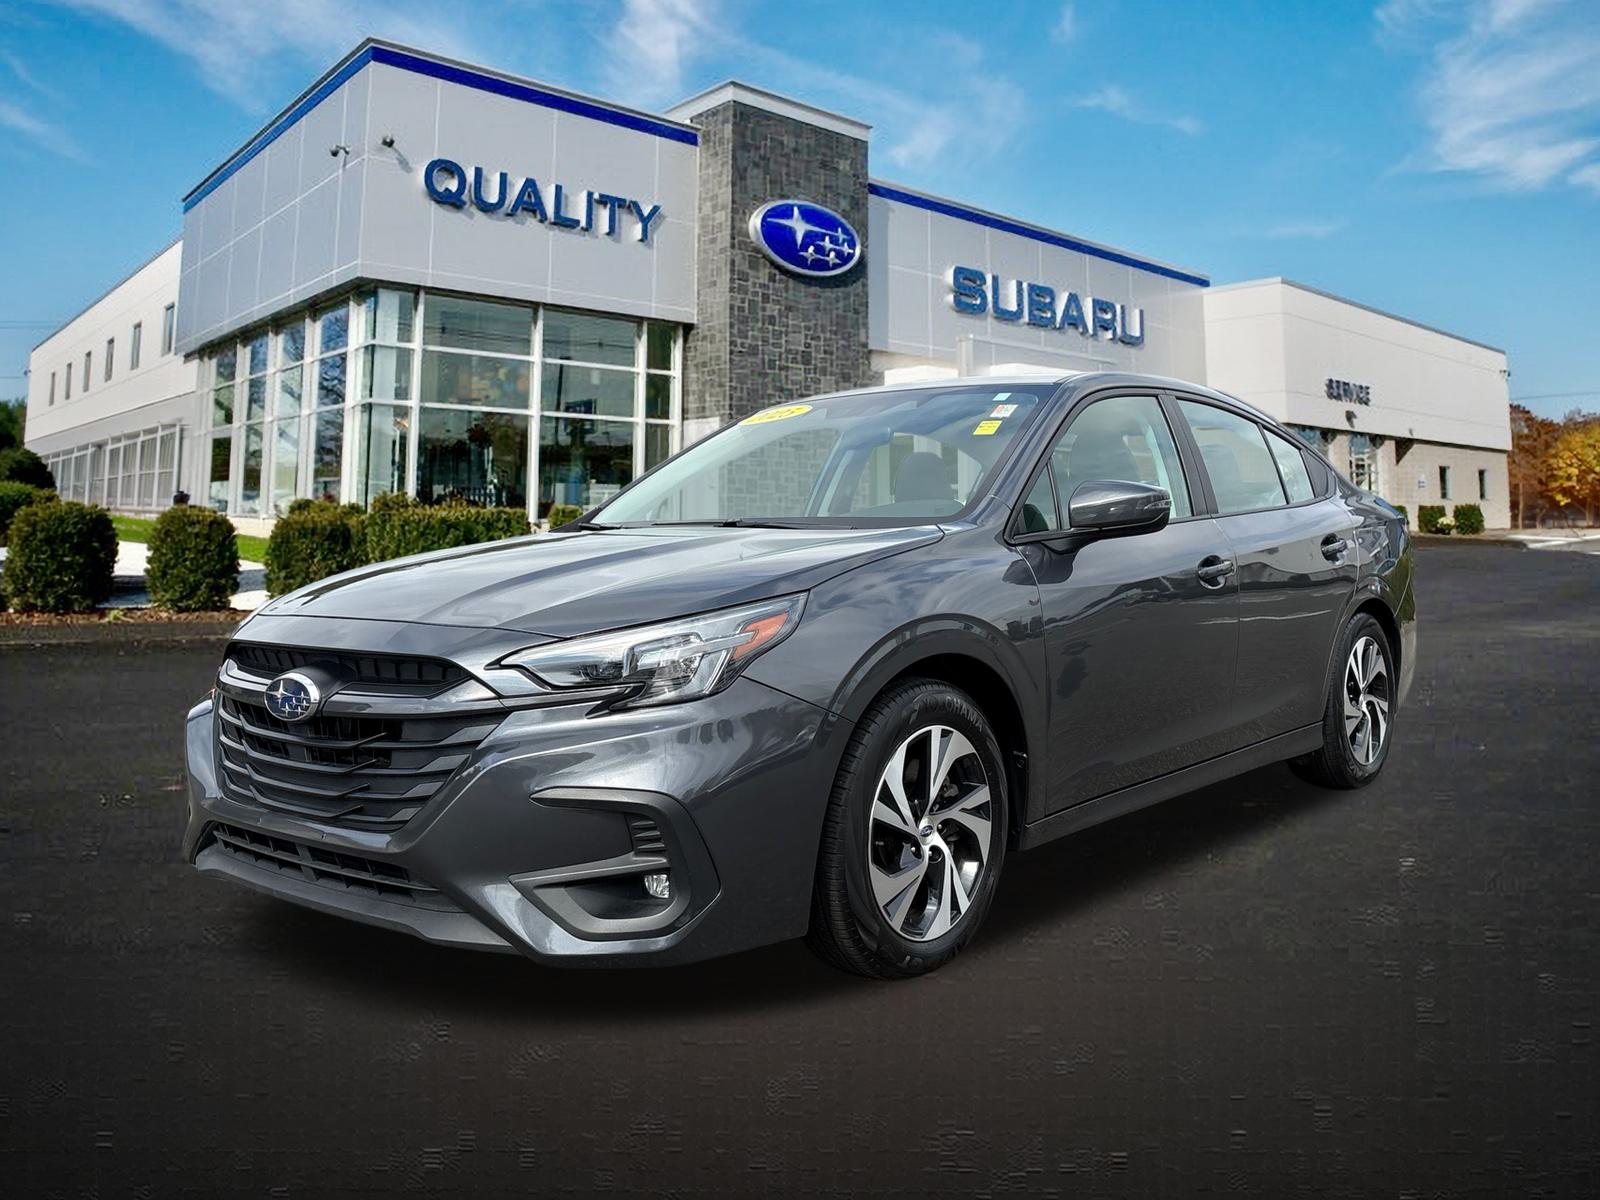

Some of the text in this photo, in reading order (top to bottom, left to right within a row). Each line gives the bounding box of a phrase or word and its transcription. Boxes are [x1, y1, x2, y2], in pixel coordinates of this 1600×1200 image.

[424, 158, 662, 242] QUALITY
[949, 265, 1145, 346] SUBARU
[1325, 378, 1371, 406] SERVICE
